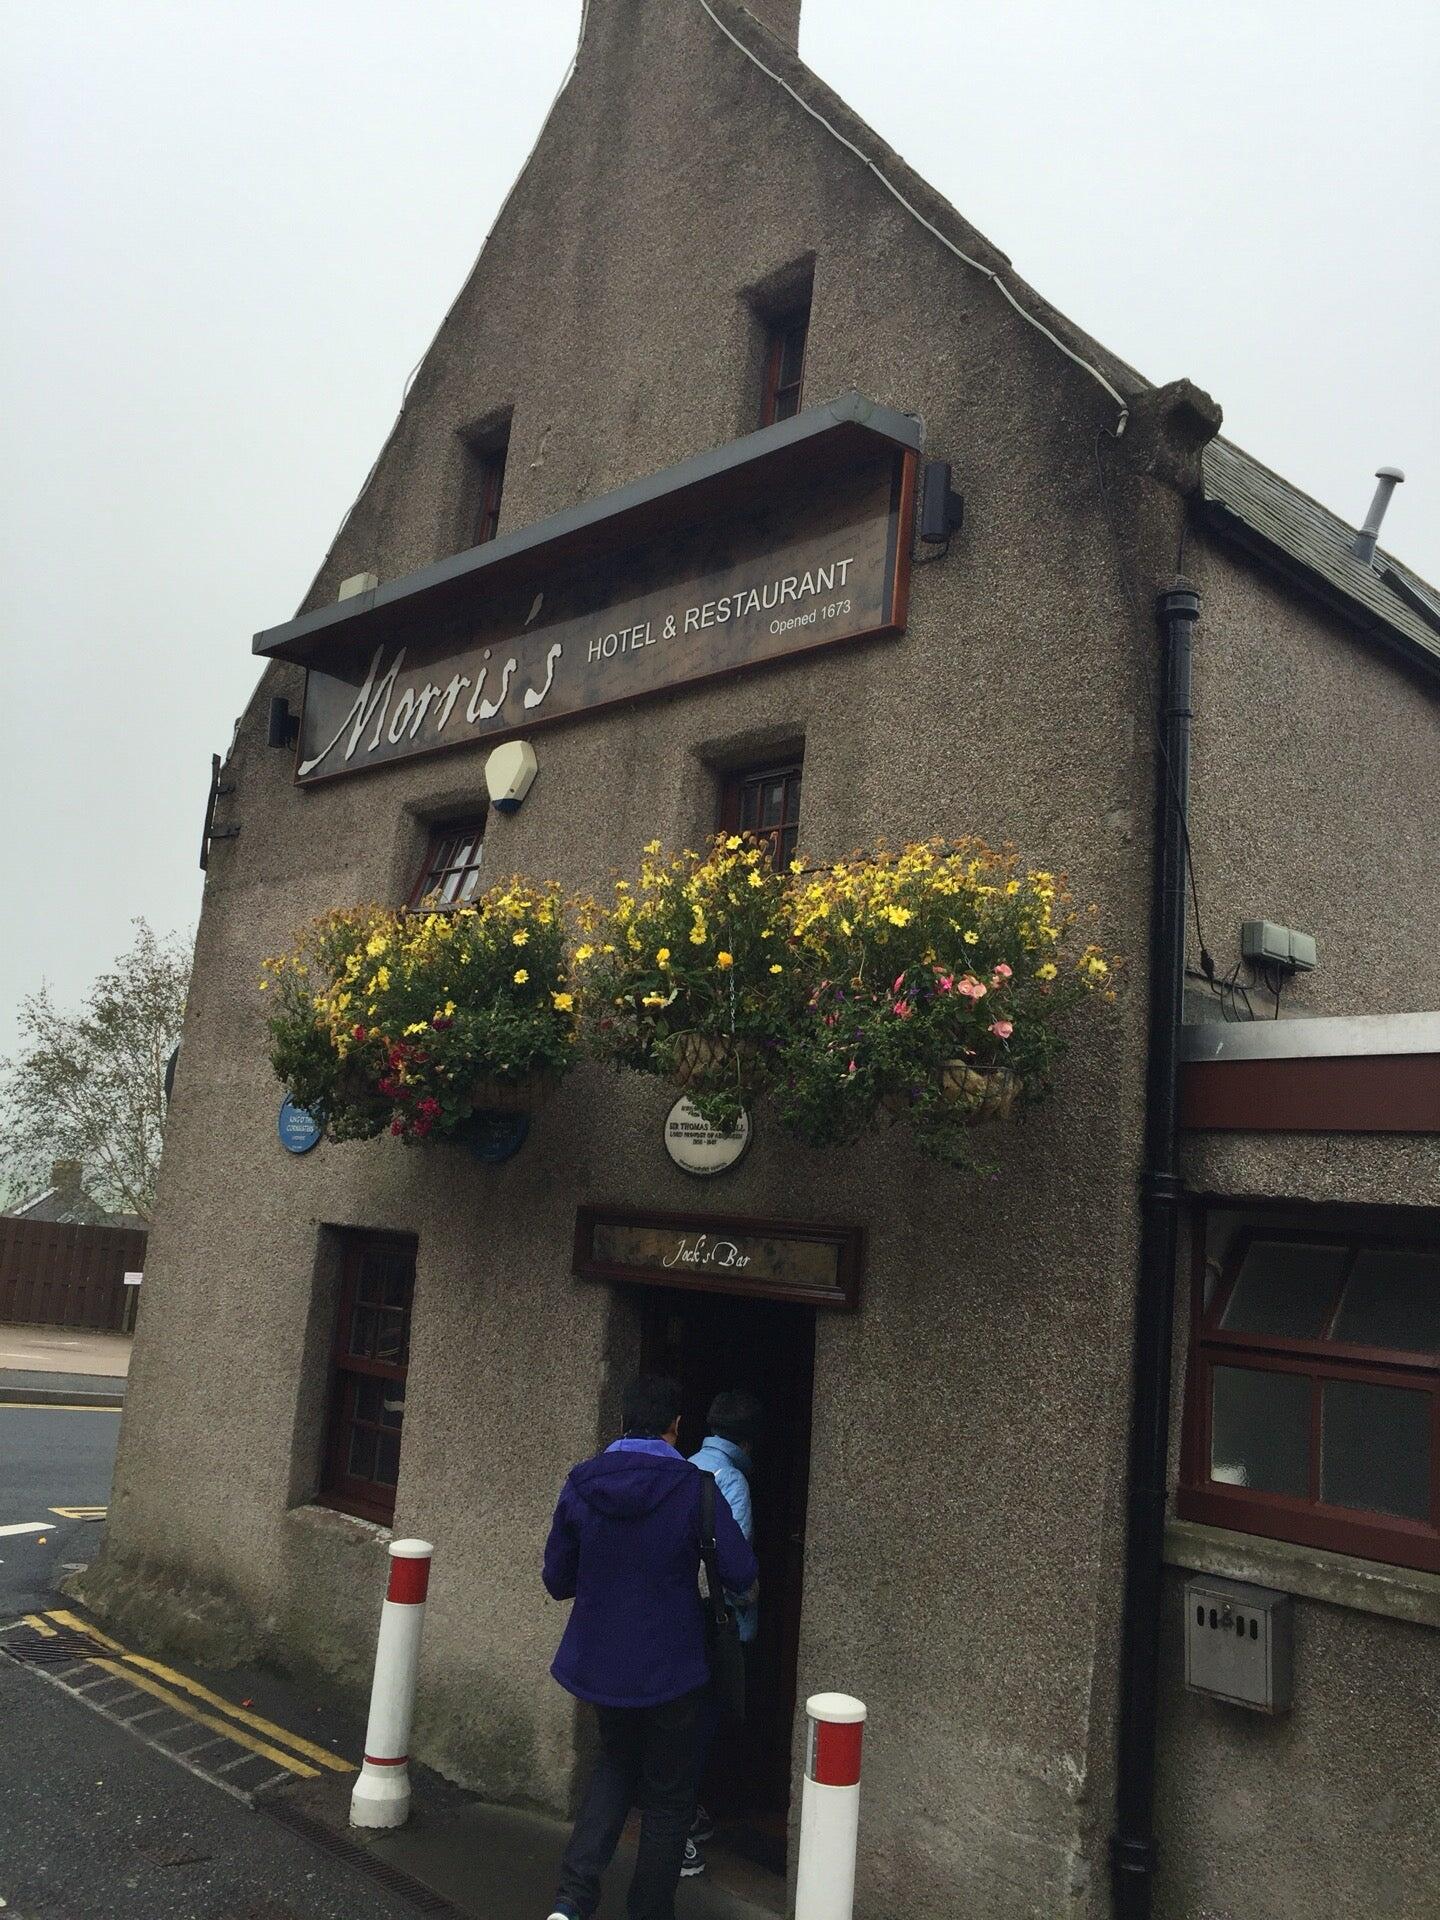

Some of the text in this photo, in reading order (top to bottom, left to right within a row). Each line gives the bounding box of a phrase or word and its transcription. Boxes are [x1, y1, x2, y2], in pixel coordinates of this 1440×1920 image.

[587, 558, 855, 664] HOTEL & RESTAURANT
[769, 599, 852, 637] Opened 1673
[298, 592, 562, 775] Morris's
[680, 1122, 709, 1132] THOMAS
[711, 1241, 751, 1267] Bar
